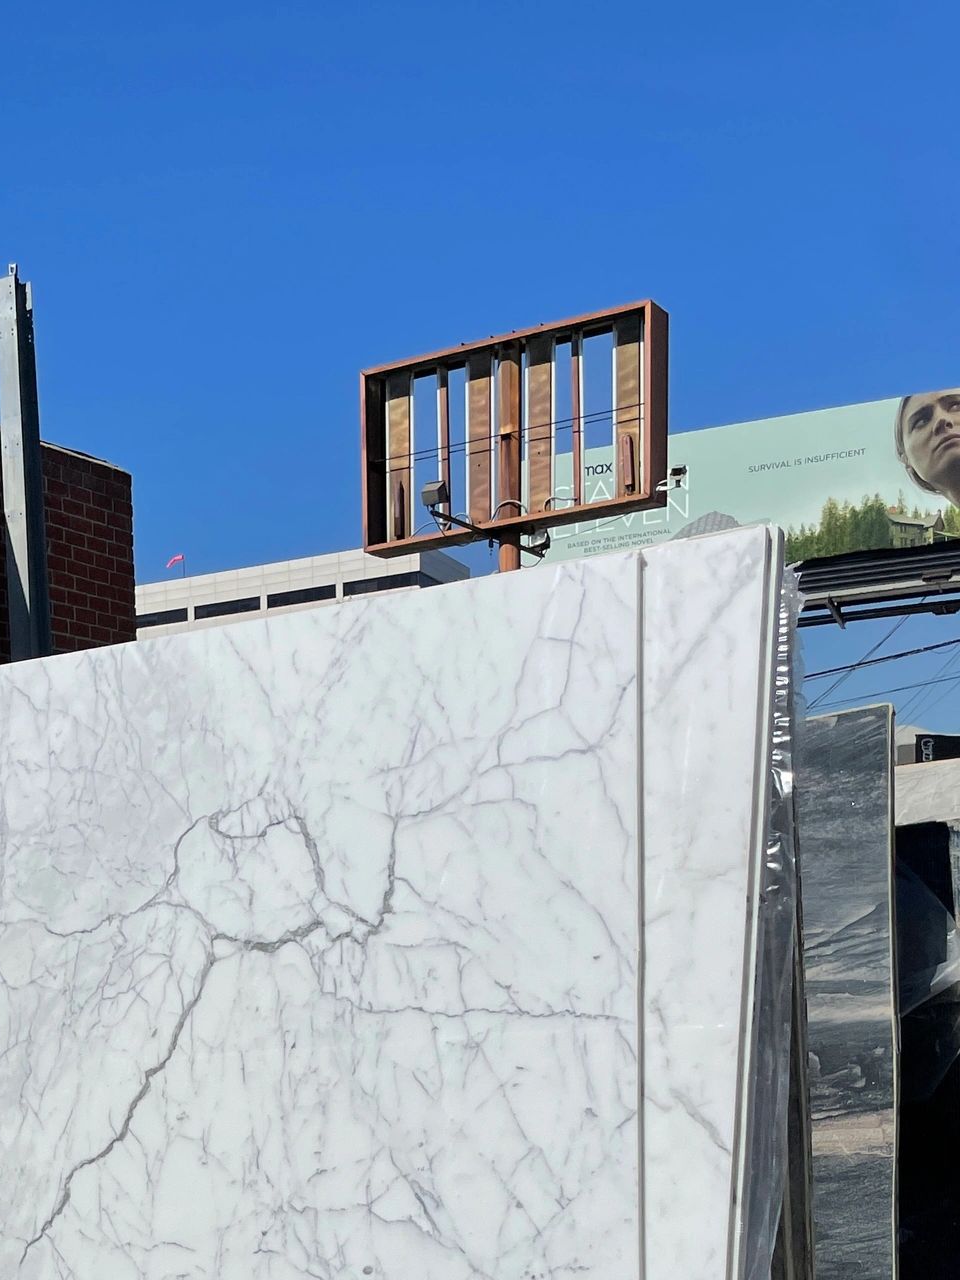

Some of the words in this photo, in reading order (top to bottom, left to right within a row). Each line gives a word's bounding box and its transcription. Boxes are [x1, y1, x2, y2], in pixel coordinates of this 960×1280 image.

[585, 462, 613, 476] max
[748, 460, 791, 473] SURVIVAL
[794, 458, 802, 466] IS
[804, 448, 866, 465] INSUFFICIENT
[567, 540, 589, 549] BASED
[618, 529, 672, 542] INTERNATIONAL
[584, 541, 630, 553] BEST-SELLING
[632, 538, 654, 547] NOVEL
